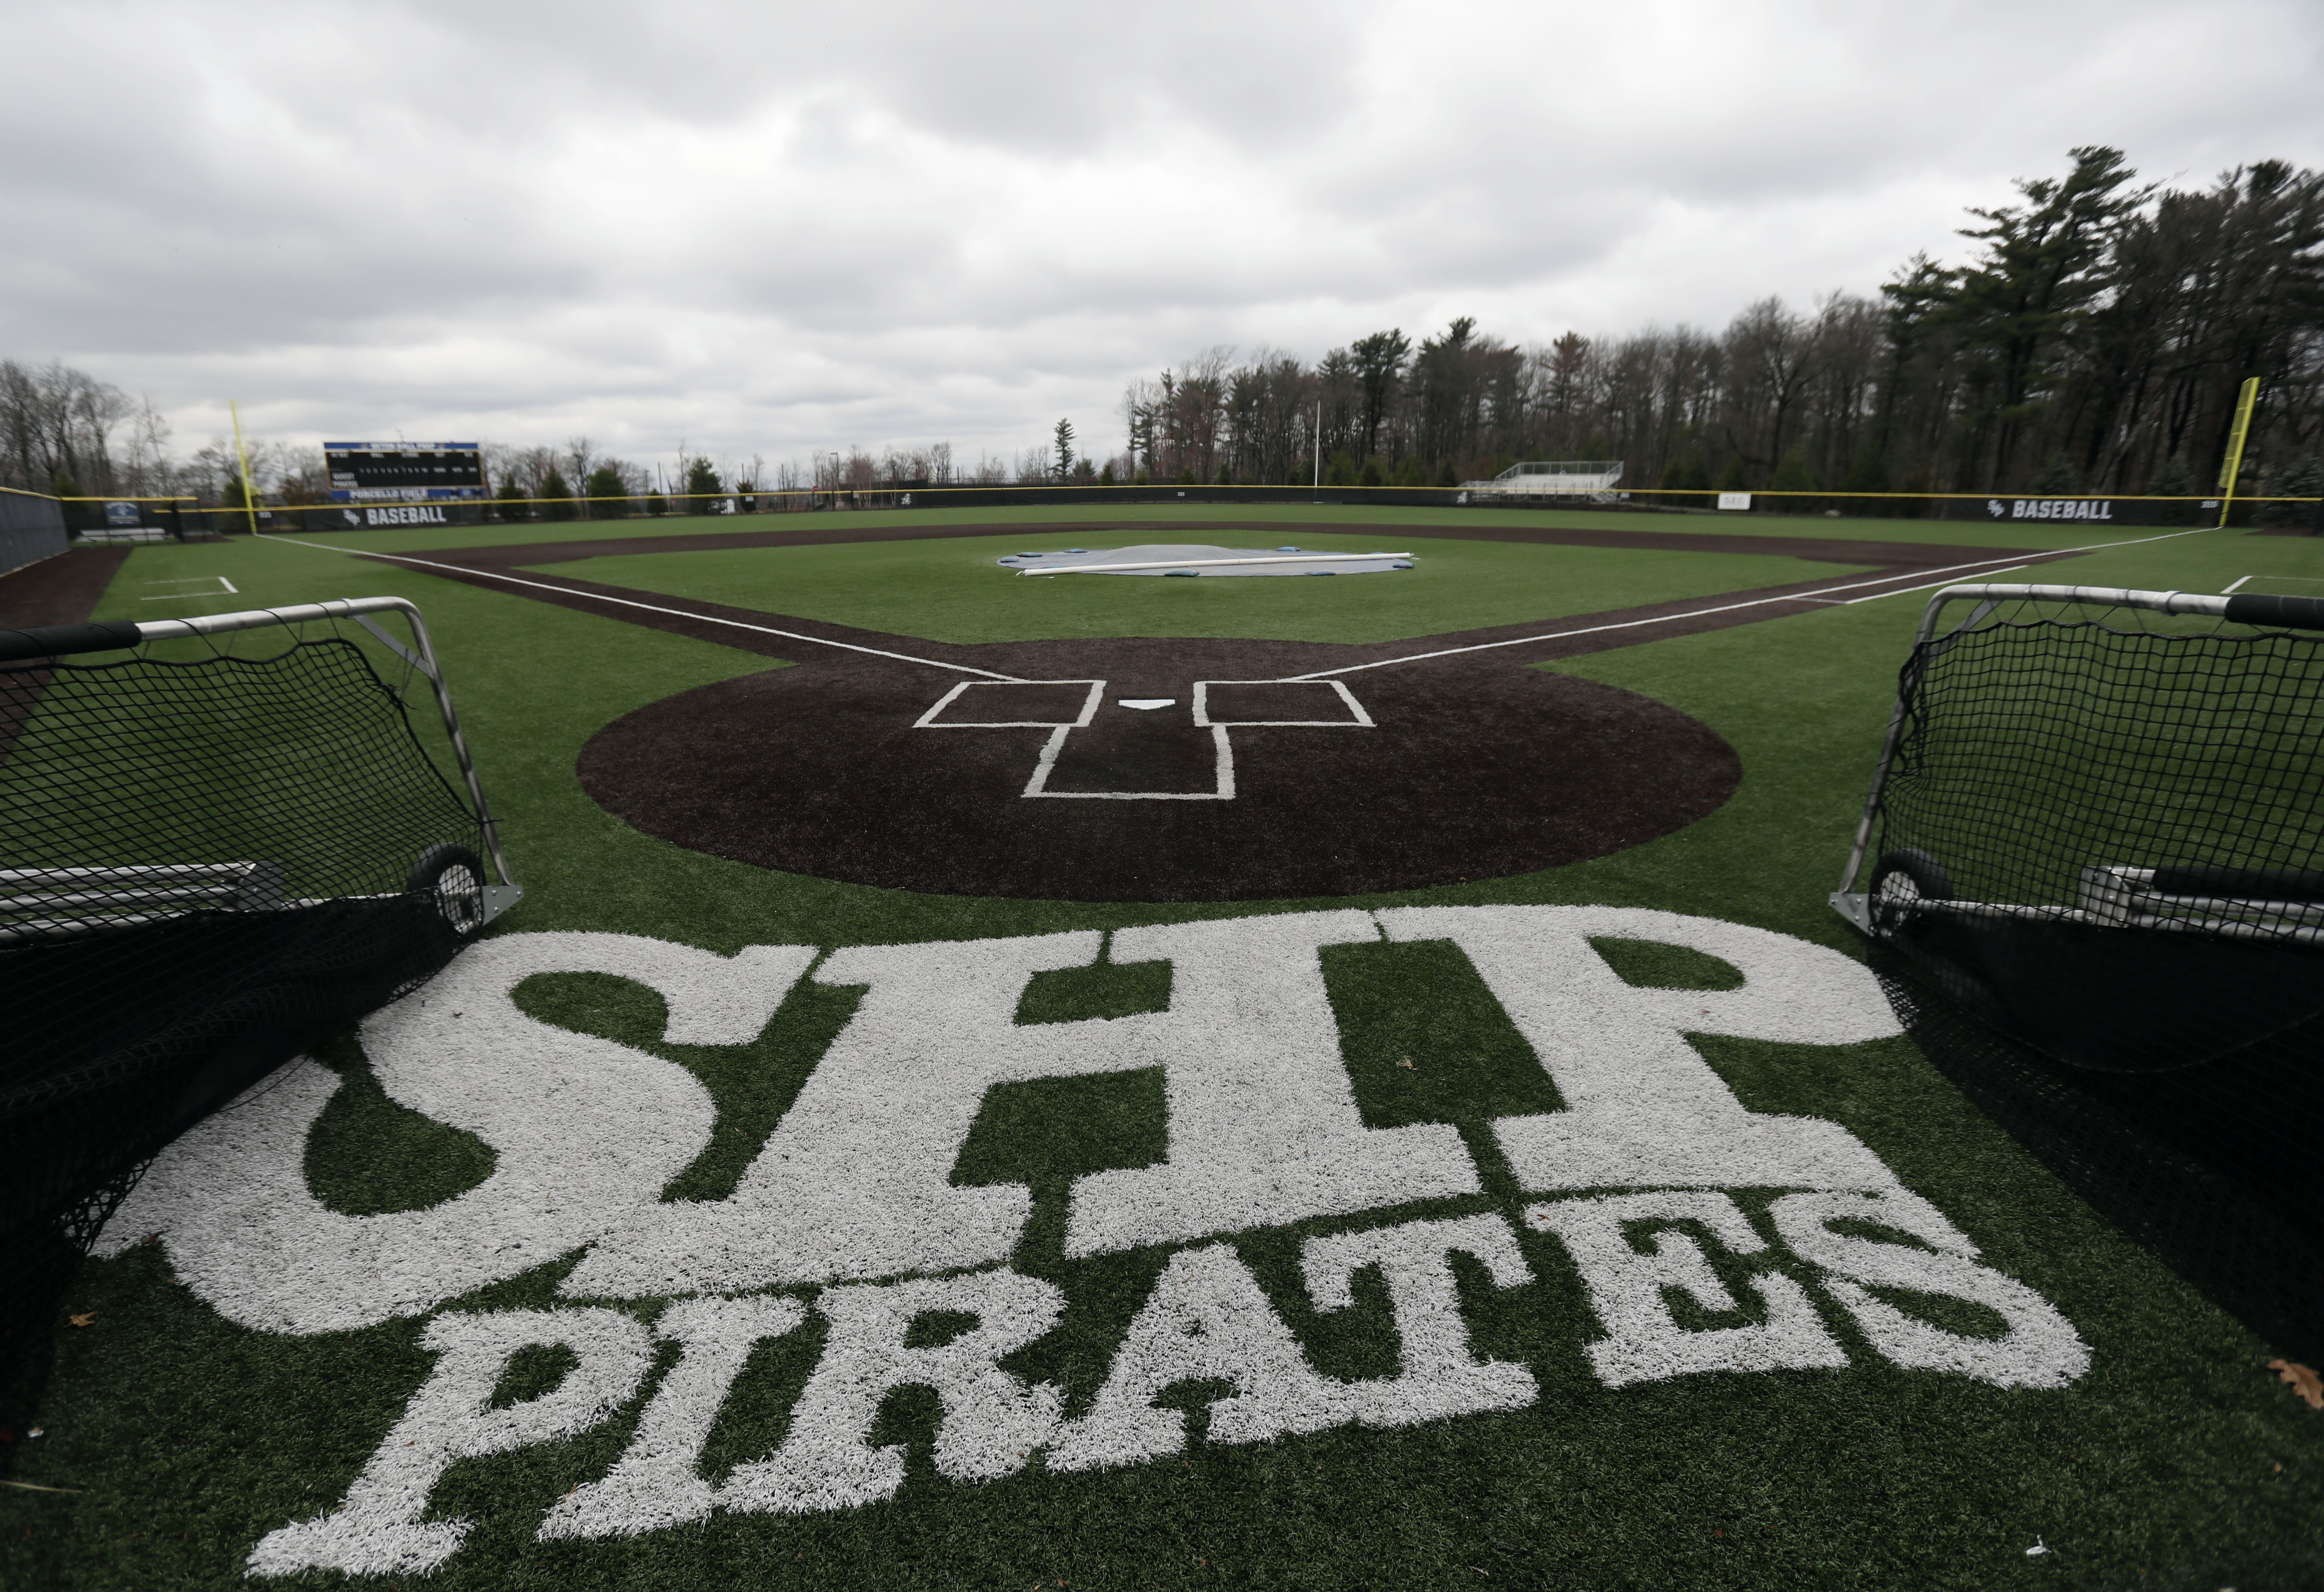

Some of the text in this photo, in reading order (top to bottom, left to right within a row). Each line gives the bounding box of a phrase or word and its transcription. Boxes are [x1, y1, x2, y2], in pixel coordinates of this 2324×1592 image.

[332, 472, 354, 480] GUEST
[349, 489, 428, 499] PORCELLO FIELD
[366, 506, 447, 525] BASEBALL
[2011, 500, 2112, 519] BASEBALL
[71, 903, 1906, 1337] SHP
[244, 1190, 2092, 1578] PIRATES
